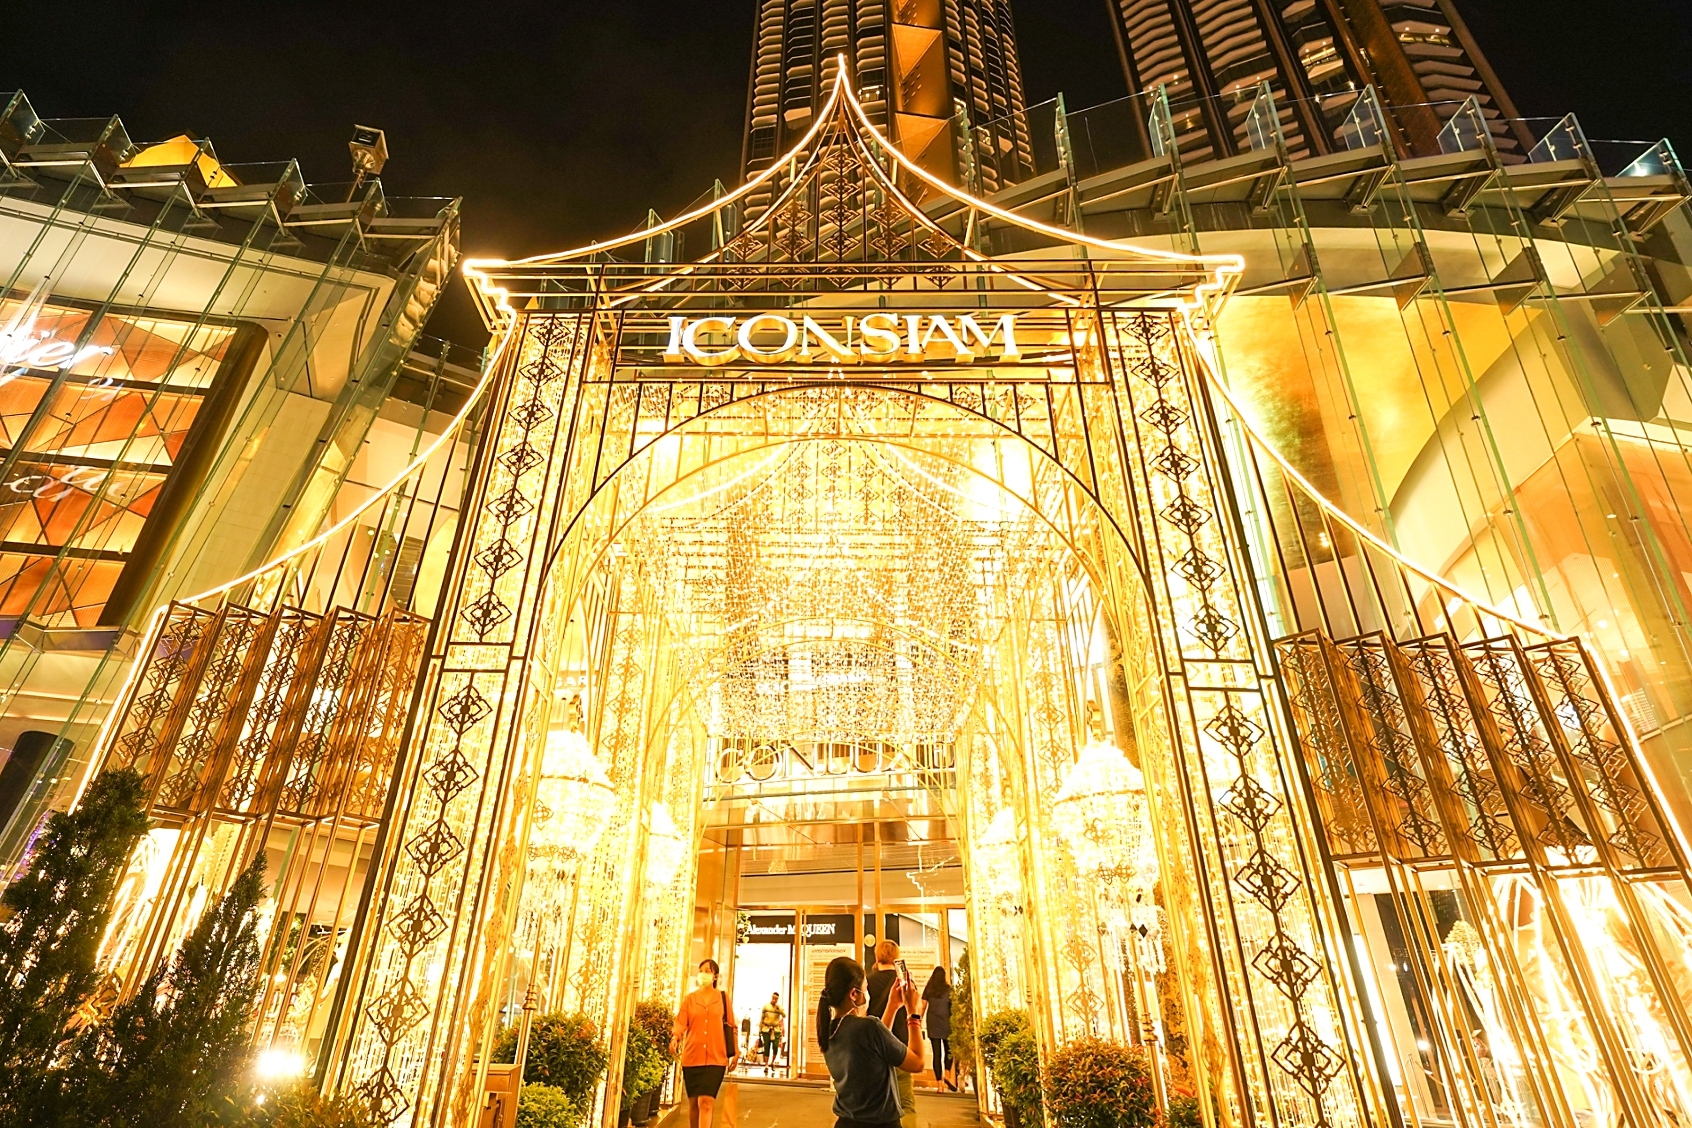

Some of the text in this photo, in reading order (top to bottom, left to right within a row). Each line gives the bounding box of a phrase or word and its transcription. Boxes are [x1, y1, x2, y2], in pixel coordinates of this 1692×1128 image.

[662, 312, 1021, 361] ICONSIAM
[745, 923, 836, 937] Alexander MQUEEN
